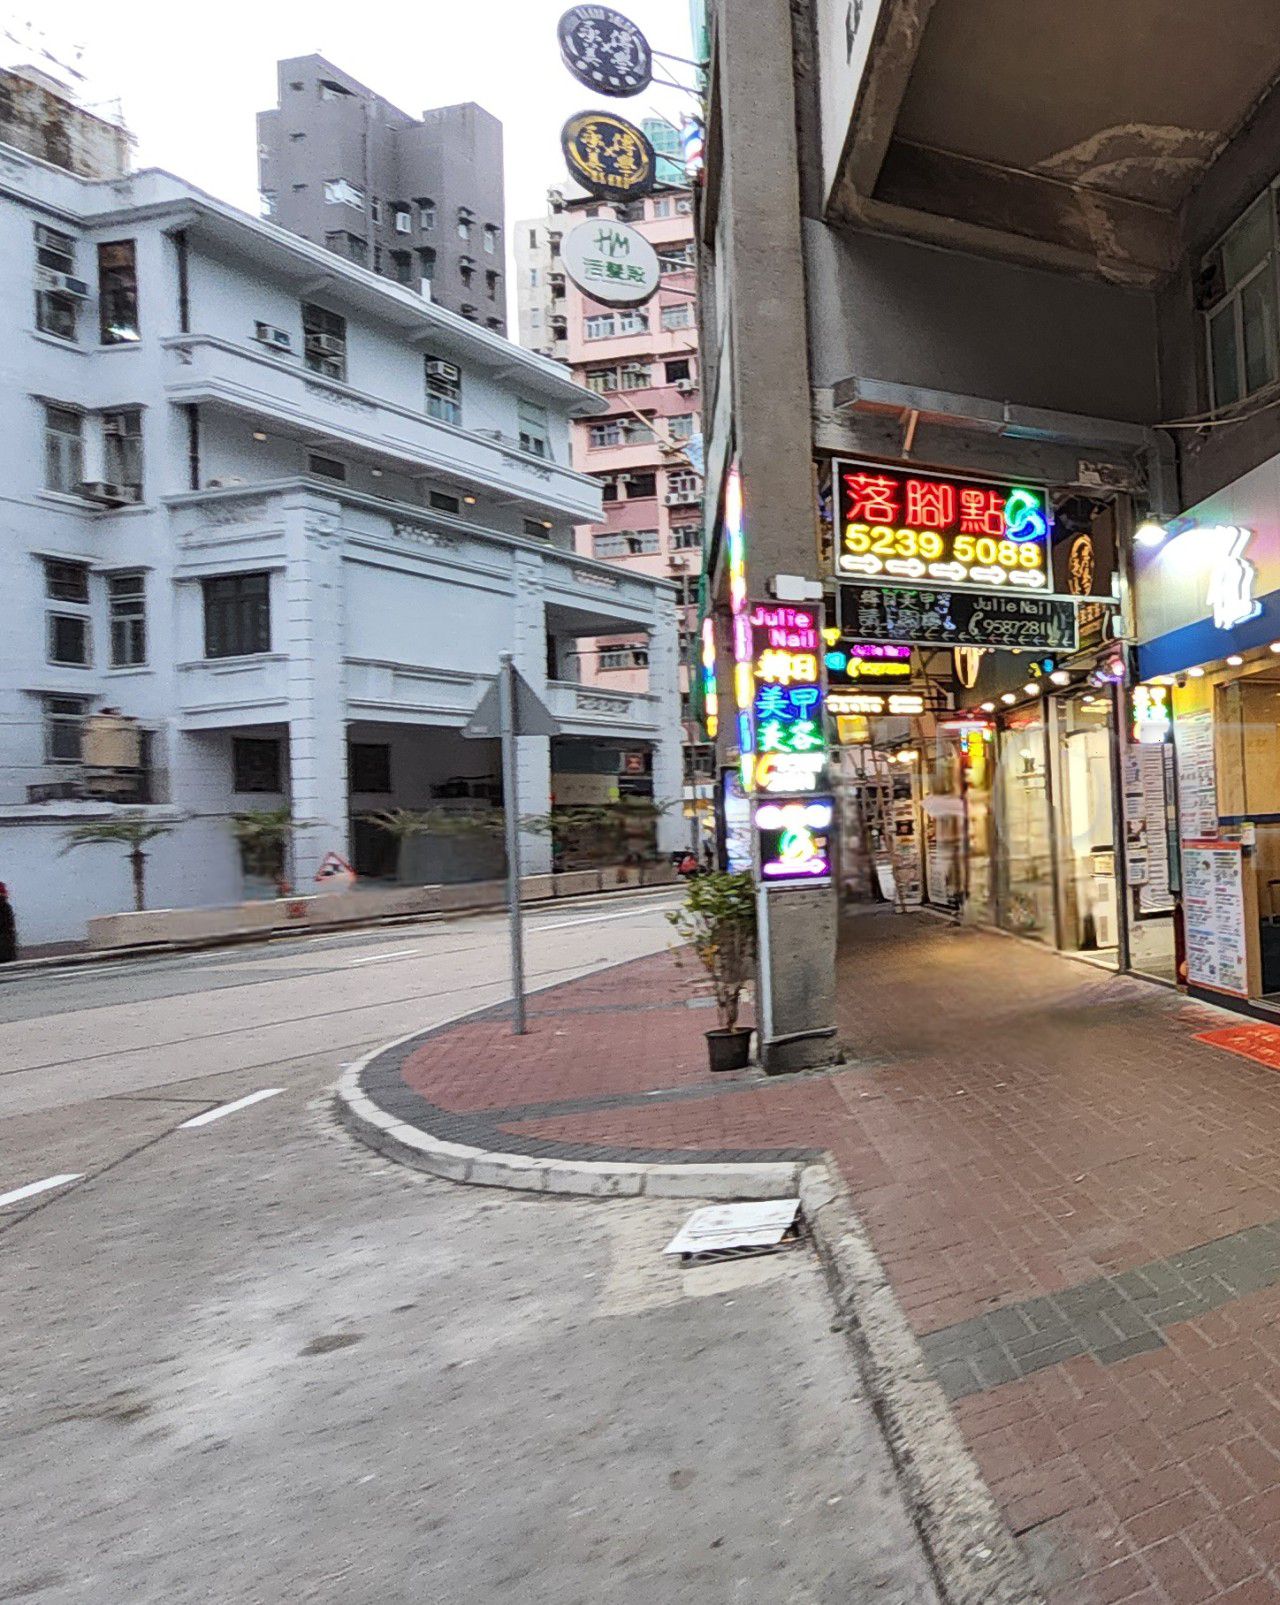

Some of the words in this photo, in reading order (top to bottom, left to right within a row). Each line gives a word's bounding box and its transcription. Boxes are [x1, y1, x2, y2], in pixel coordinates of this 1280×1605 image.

[843, 471, 1006, 536] 落腳點
[844, 524, 943, 559] 5239
[952, 535, 1042, 568] 5088
[750, 607, 812, 627] Julie
[973, 597, 1018, 612] Julie
[1020, 600, 1052, 616] Nail
[769, 628, 817, 648] Nail
[756, 685, 819, 719] 美甲
